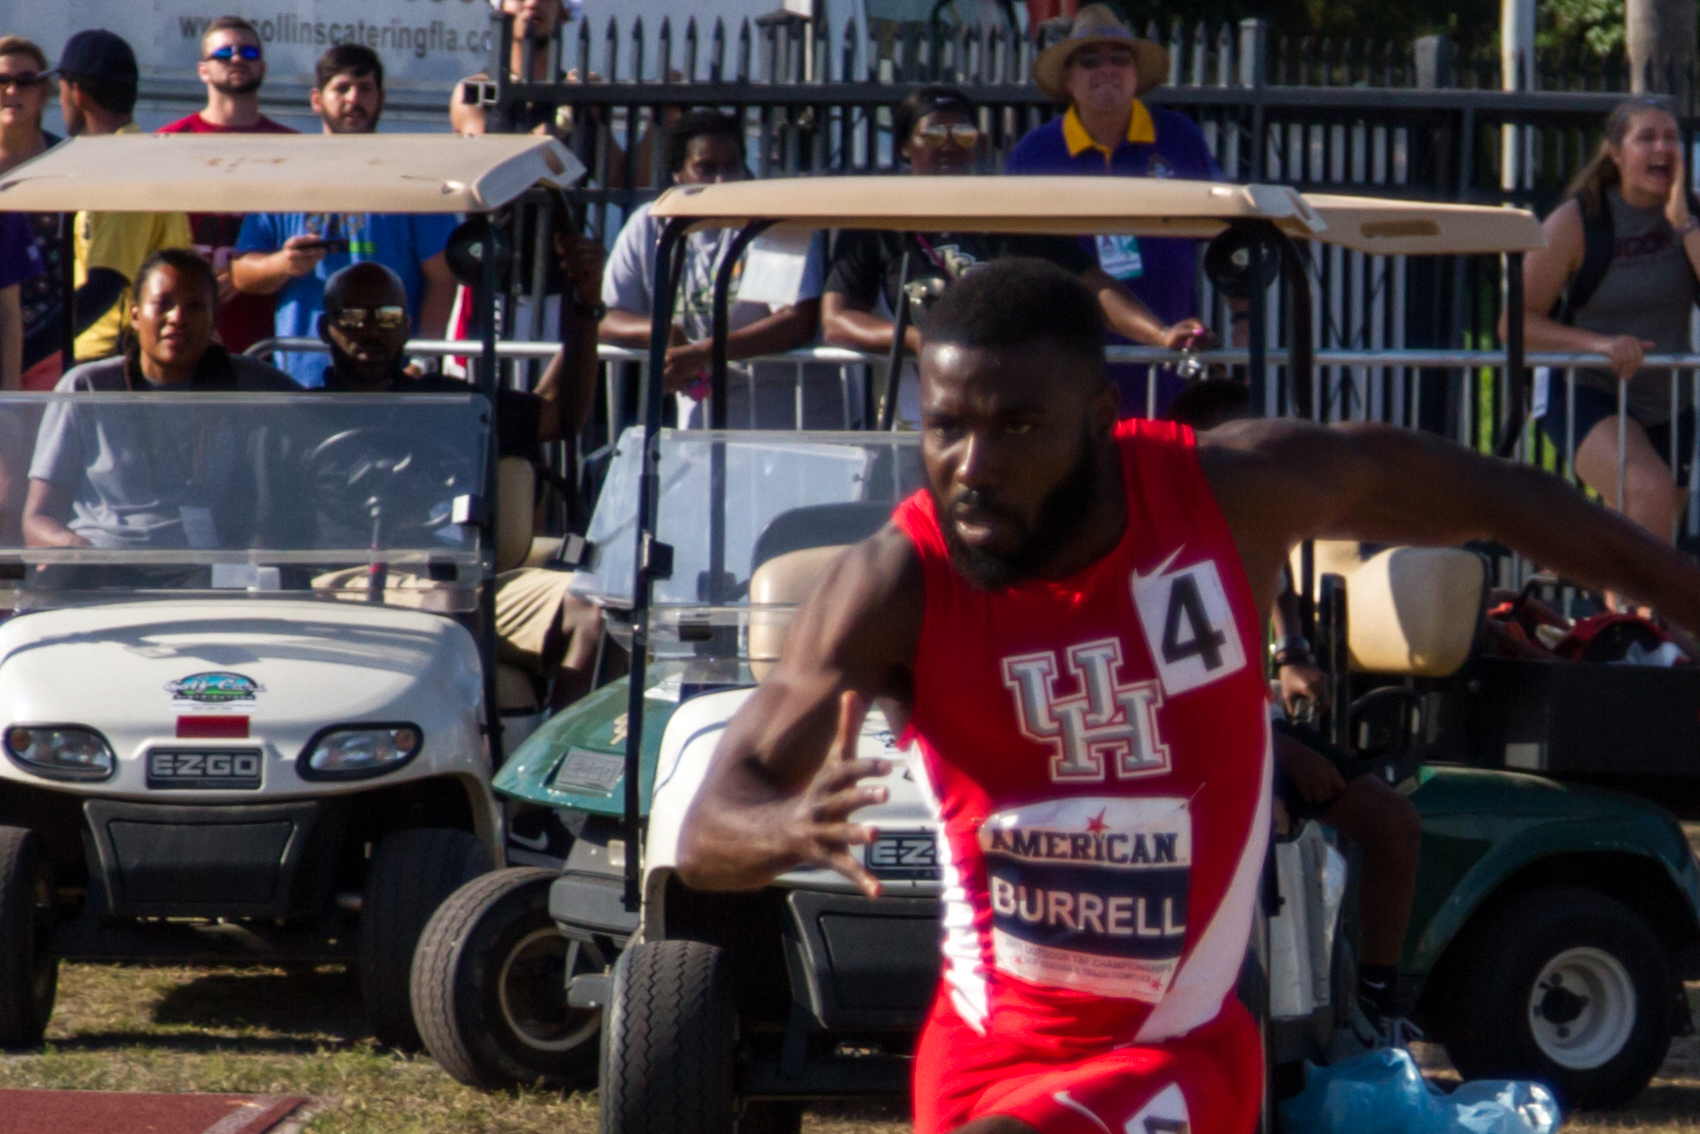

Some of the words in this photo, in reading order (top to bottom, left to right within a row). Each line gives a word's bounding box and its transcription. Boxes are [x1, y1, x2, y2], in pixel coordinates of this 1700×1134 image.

[1161, 571, 1227, 672] 4
[1001, 637, 1172, 782] UH
[990, 828, 1180, 864] AMERICAN
[992, 875, 1187, 937] BURRELL
[1093, 957, 1173, 973] CHAMPIONSHIPS
